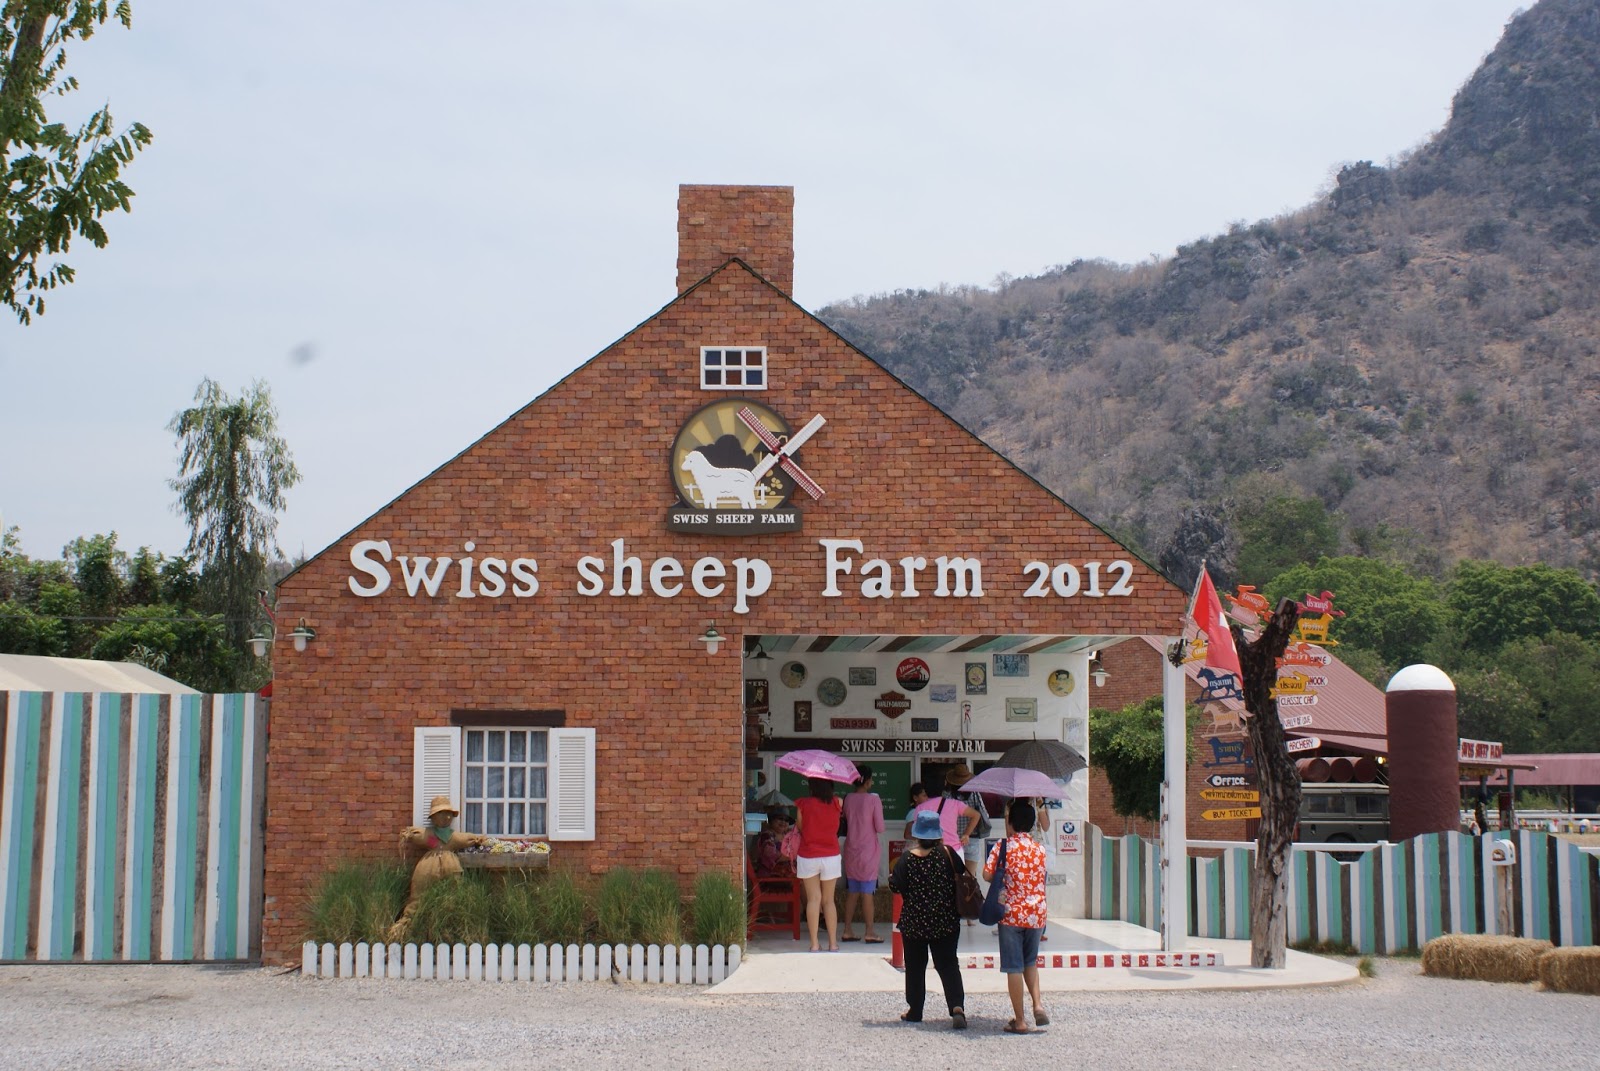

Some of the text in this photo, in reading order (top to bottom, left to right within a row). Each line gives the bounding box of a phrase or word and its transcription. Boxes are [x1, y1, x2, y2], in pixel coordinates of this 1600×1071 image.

[673, 513, 795, 524] SWISS SHEEP FARM
[347, 537, 1135, 615] Swiss sheep Farm 2012
[841, 739, 986, 753] SWISS SHEEP FARM
[1213, 809, 1253, 819] BUY TICKET
